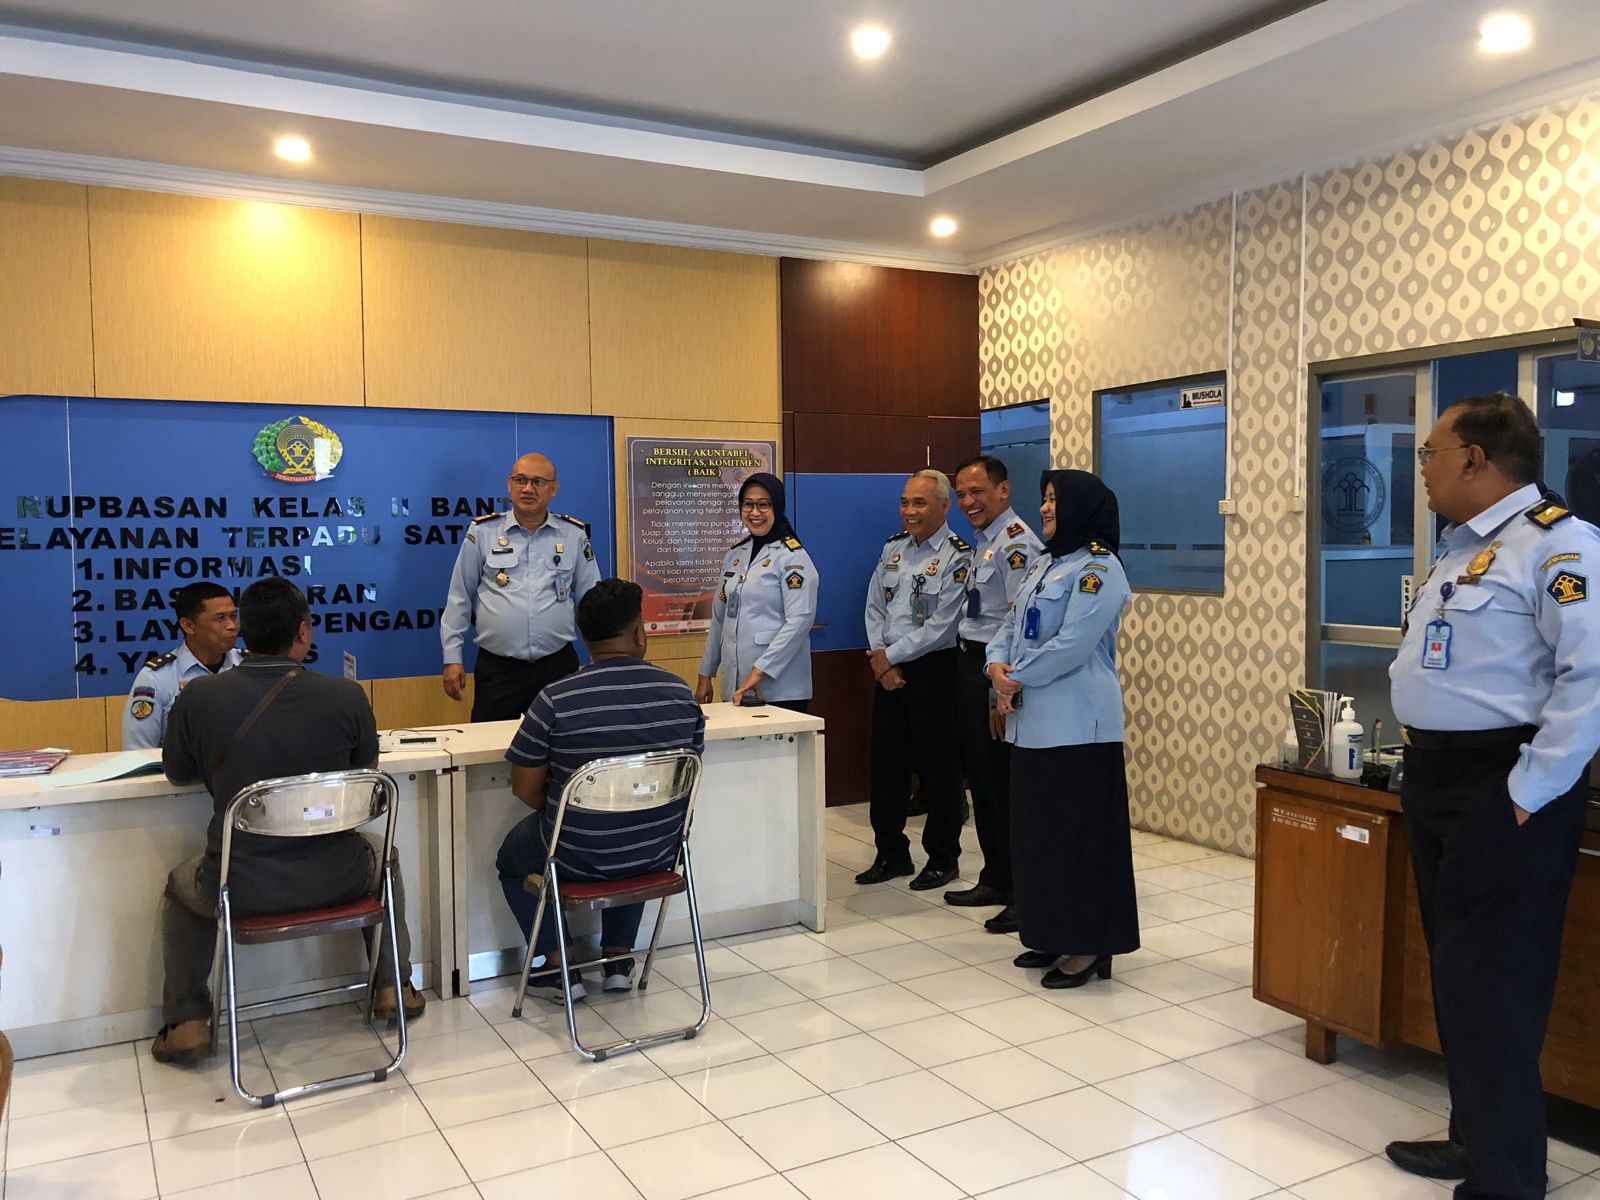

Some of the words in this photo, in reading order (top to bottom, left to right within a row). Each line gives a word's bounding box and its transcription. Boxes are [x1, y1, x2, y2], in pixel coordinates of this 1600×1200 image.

[1192, 389, 1221, 400] MUSHOLA
[653, 447, 691, 457] BERSIH,
[645, 457, 706, 467] INTEGRITAS,
[709, 459, 761, 467] KOMITMEN
[651, 481, 682, 490] Dengan
[651, 491, 685, 499] sanggup
[16, 495, 227, 518] RUPBASAN
[252, 497, 366, 518] KELAS
[431, 497, 514, 518] BANT
[697, 499, 726, 507] dengan
[642, 507, 684, 515] pelayanan
[685, 508, 704, 516] yang
[651, 520, 670, 528] Tidak
[0, 527, 199, 549] ELAYANAN
[221, 524, 381, 548] TERPADU
[404, 524, 468, 546] SAT
[114, 554, 312, 580] INFORMASI
[306, 583, 376, 605] RAN
[311, 608, 445, 634] PENGAD
